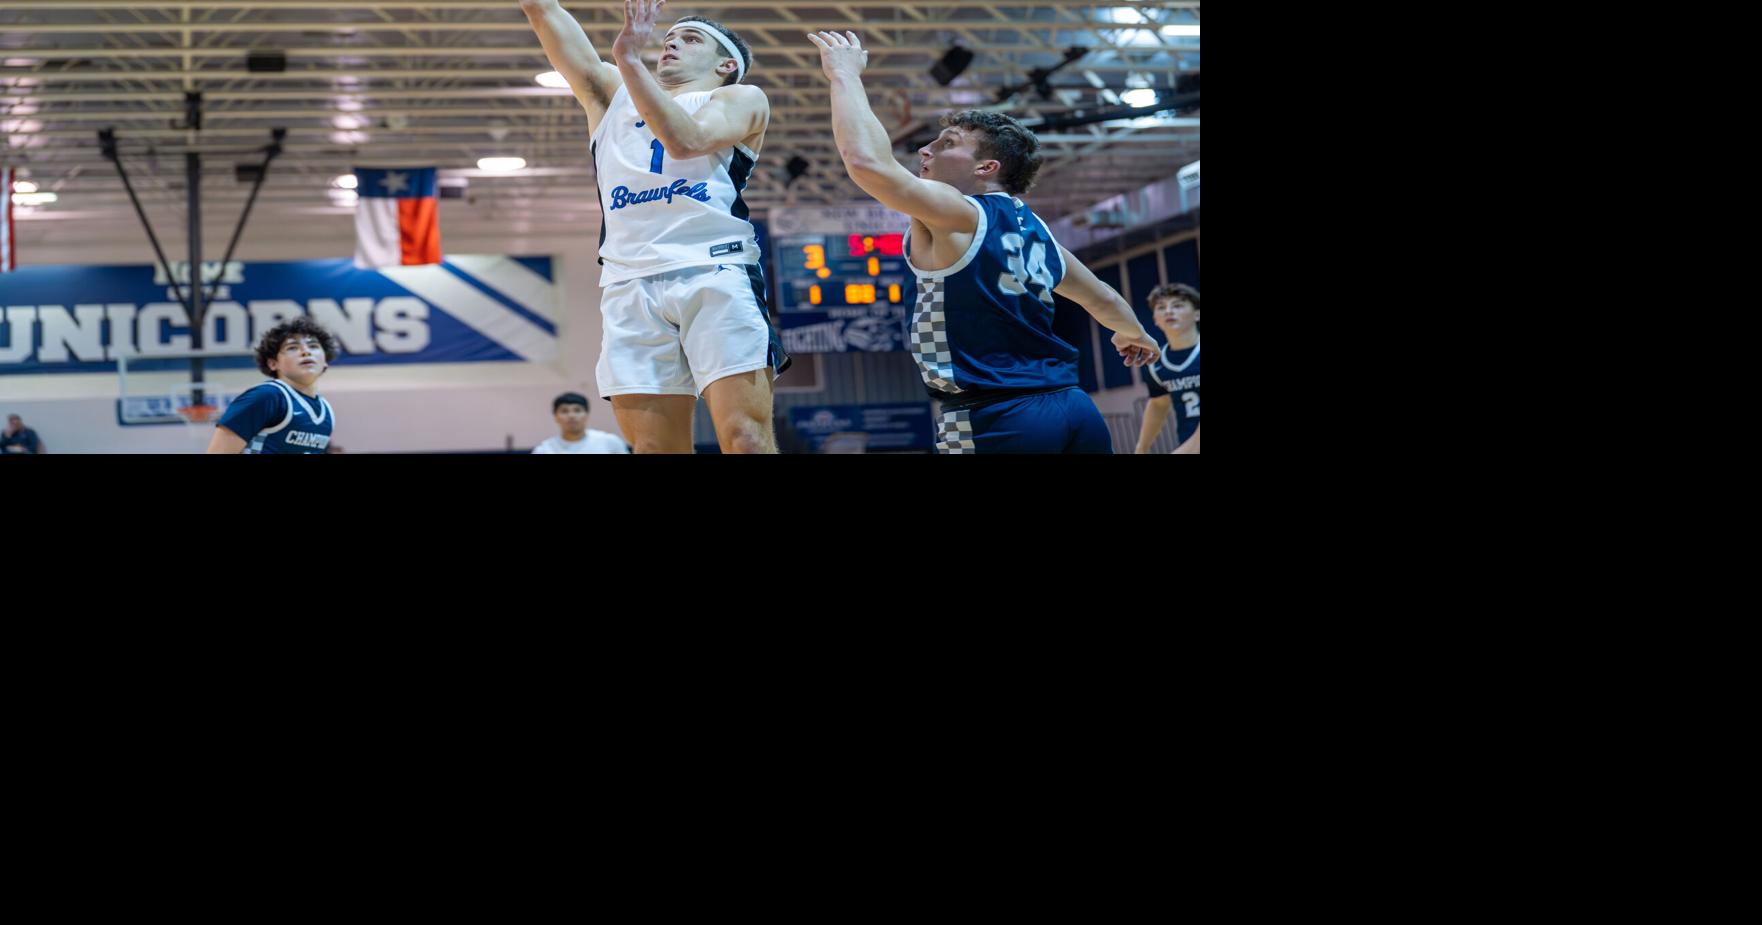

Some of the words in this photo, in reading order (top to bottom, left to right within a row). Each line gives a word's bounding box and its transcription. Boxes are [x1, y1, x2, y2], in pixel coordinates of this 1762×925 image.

[650, 138, 664, 174] 1
[610, 178, 711, 210] Braunfels
[998, 232, 1054, 303] 34
[0, 298, 430, 363] UNICORNS
[1181, 391, 1200, 418] 2
